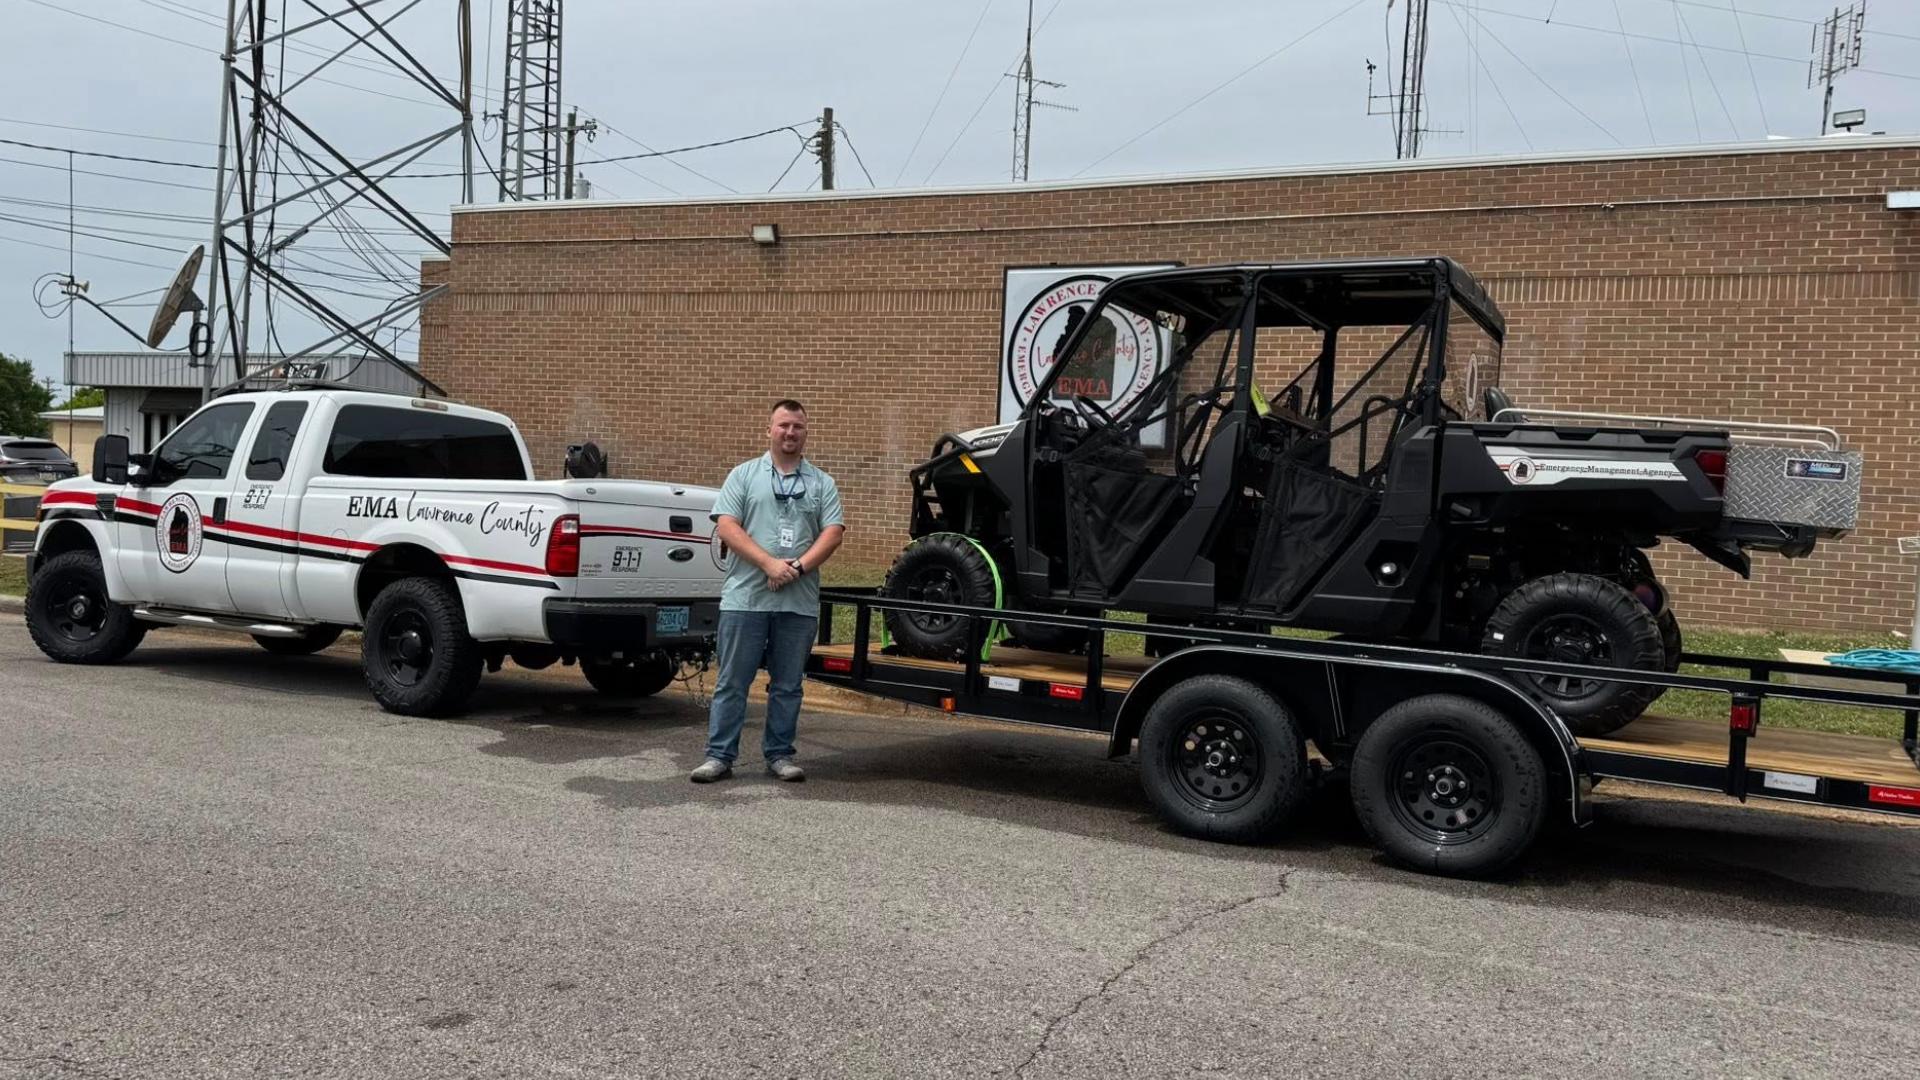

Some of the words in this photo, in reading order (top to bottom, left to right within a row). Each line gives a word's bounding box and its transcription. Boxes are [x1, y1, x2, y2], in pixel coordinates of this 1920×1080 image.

[1024, 283, 1097, 334] LAWRENCE
[1017, 345, 1035, 399] EMERGE
[1057, 377, 1109, 396] EMA
[1539, 463, 1585, 473] Emergency
[1587, 465, 1640, 476] Management
[1642, 468, 1674, 478] Agency
[243, 488, 272, 504] 9-1-1
[346, 495, 399, 518] EMA
[406, 490, 475, 526] Lawrence
[480, 501, 547, 547] County
[612, 551, 642, 567] 9-1-1
[688, 581, 723, 596] DUT
